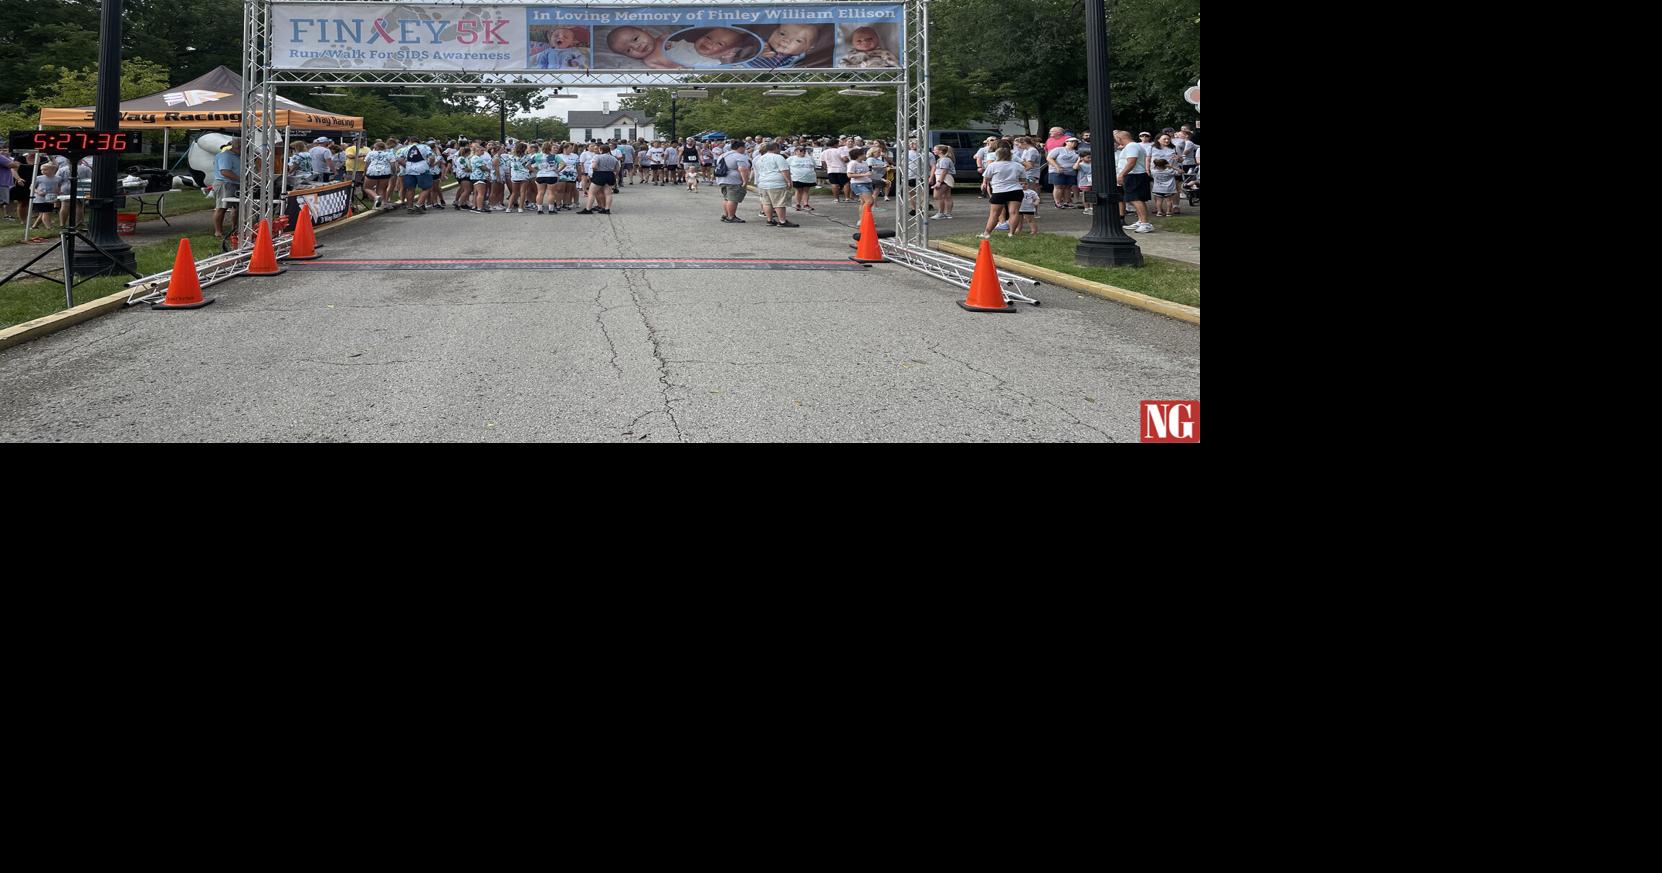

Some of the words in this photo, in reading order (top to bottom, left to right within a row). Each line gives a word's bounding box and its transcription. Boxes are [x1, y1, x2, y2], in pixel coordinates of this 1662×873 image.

[533, 10, 549, 20] In
[555, 10, 610, 22] Loving
[614, 11, 681, 22] Memory
[687, 10, 705, 20] of
[708, 10, 760, 23] Finley
[765, 9, 833, 20] William
[838, 8, 895, 19] Ellison
[456, 19, 510, 45] 5K
[289, 49, 365, 60] Run/Walk
[369, 50, 394, 60] For
[399, 50, 429, 60] SIDS
[433, 51, 511, 61] Awareness
[165, 112, 243, 123] Racing
[306, 113, 312, 122] 3
[314, 114, 331, 126] Way
[331, 116, 355, 128] Racing
